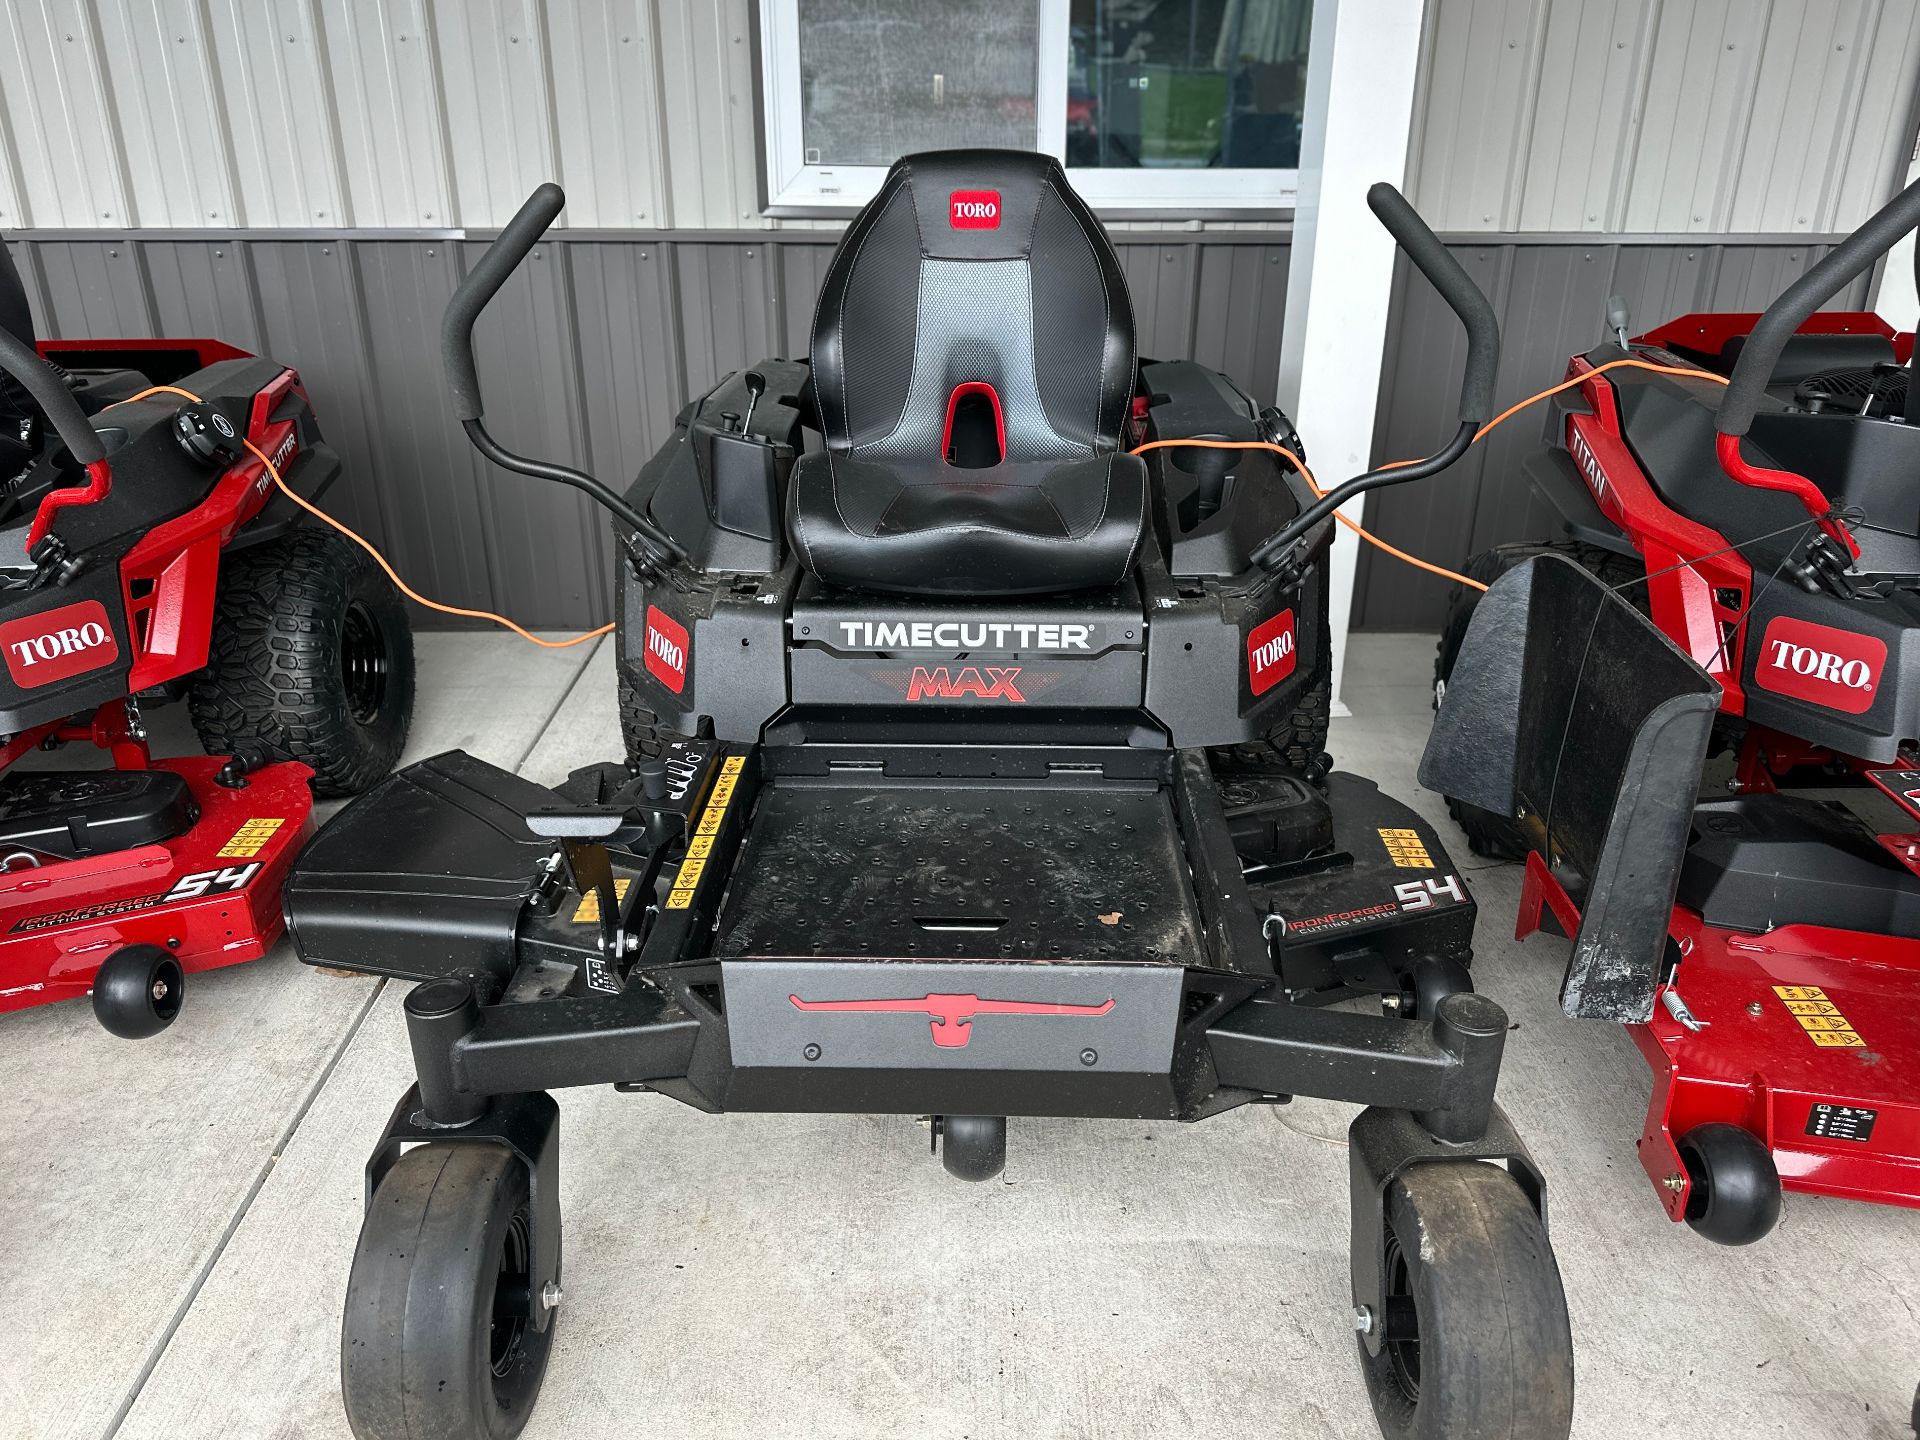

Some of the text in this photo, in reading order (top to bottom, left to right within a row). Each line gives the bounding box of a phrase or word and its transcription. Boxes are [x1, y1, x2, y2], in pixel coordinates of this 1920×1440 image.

[953, 202, 997, 218] TORO
[1573, 428, 1606, 498] TITAN
[10, 622, 106, 668] TORO
[648, 625, 683, 672] TORO
[1252, 630, 1292, 674] TORO
[1770, 639, 1871, 688] TORO
[906, 666, 1026, 702] MAX
[163, 861, 261, 902] 54
[1393, 875, 1466, 912] 54
[26, 901, 154, 930] CUTTING SYSTEM
[1299, 910, 1399, 935] CUTTING SYSTEM
